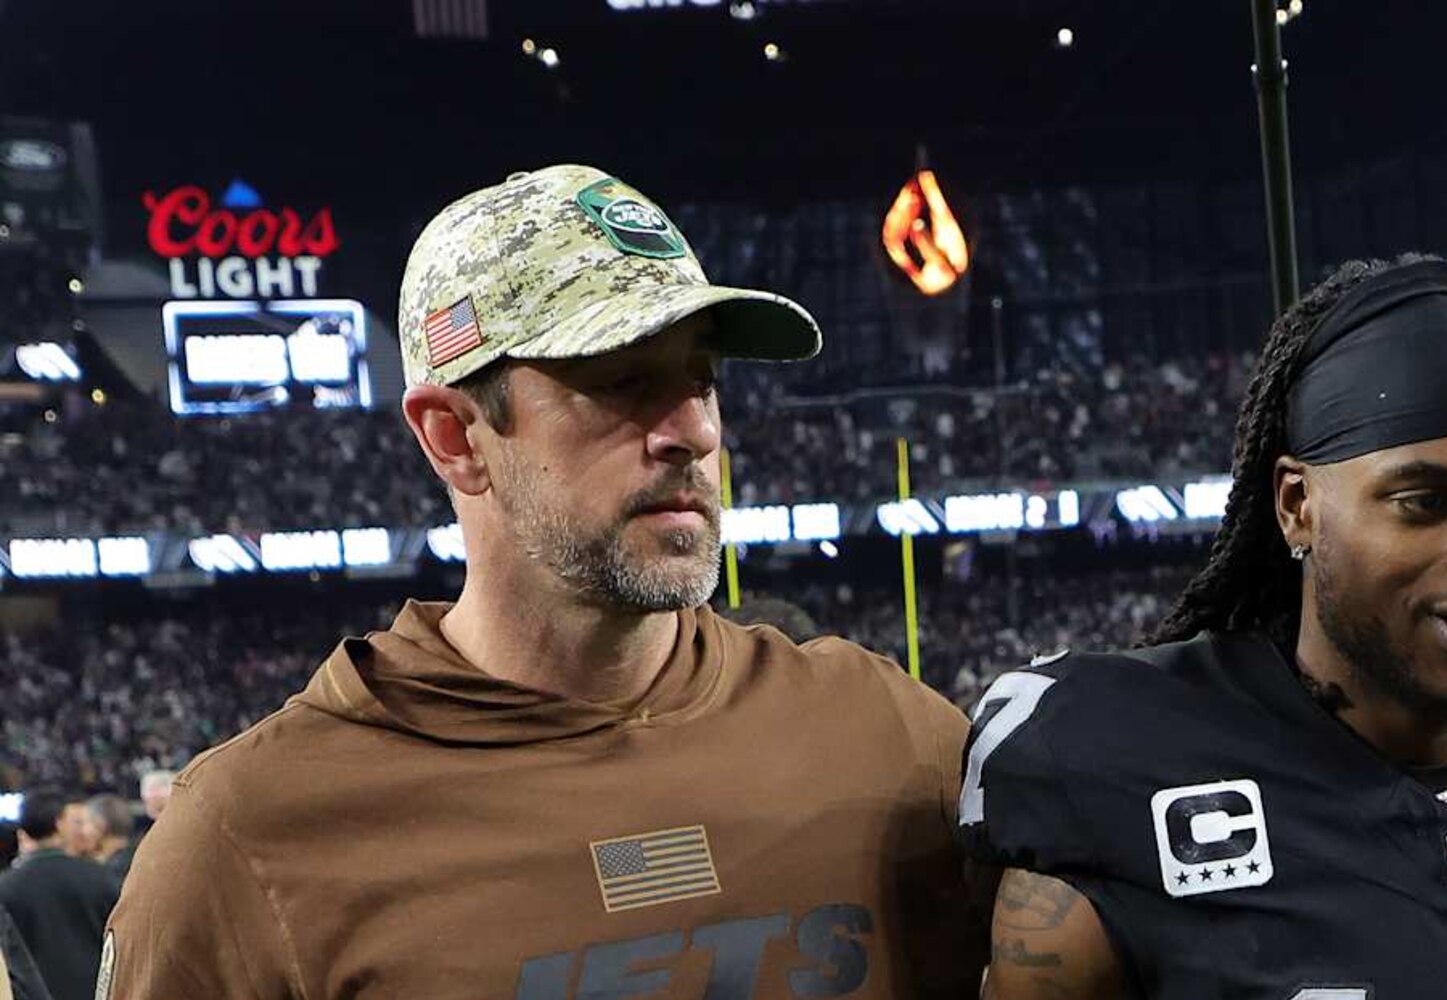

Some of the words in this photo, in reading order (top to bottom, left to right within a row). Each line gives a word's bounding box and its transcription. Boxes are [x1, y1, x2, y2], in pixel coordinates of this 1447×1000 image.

[143, 185, 340, 258] Coors
[169, 255, 322, 299] LIGHT
[960, 649, 1070, 827] 7
[1165, 790, 1257, 865] C
